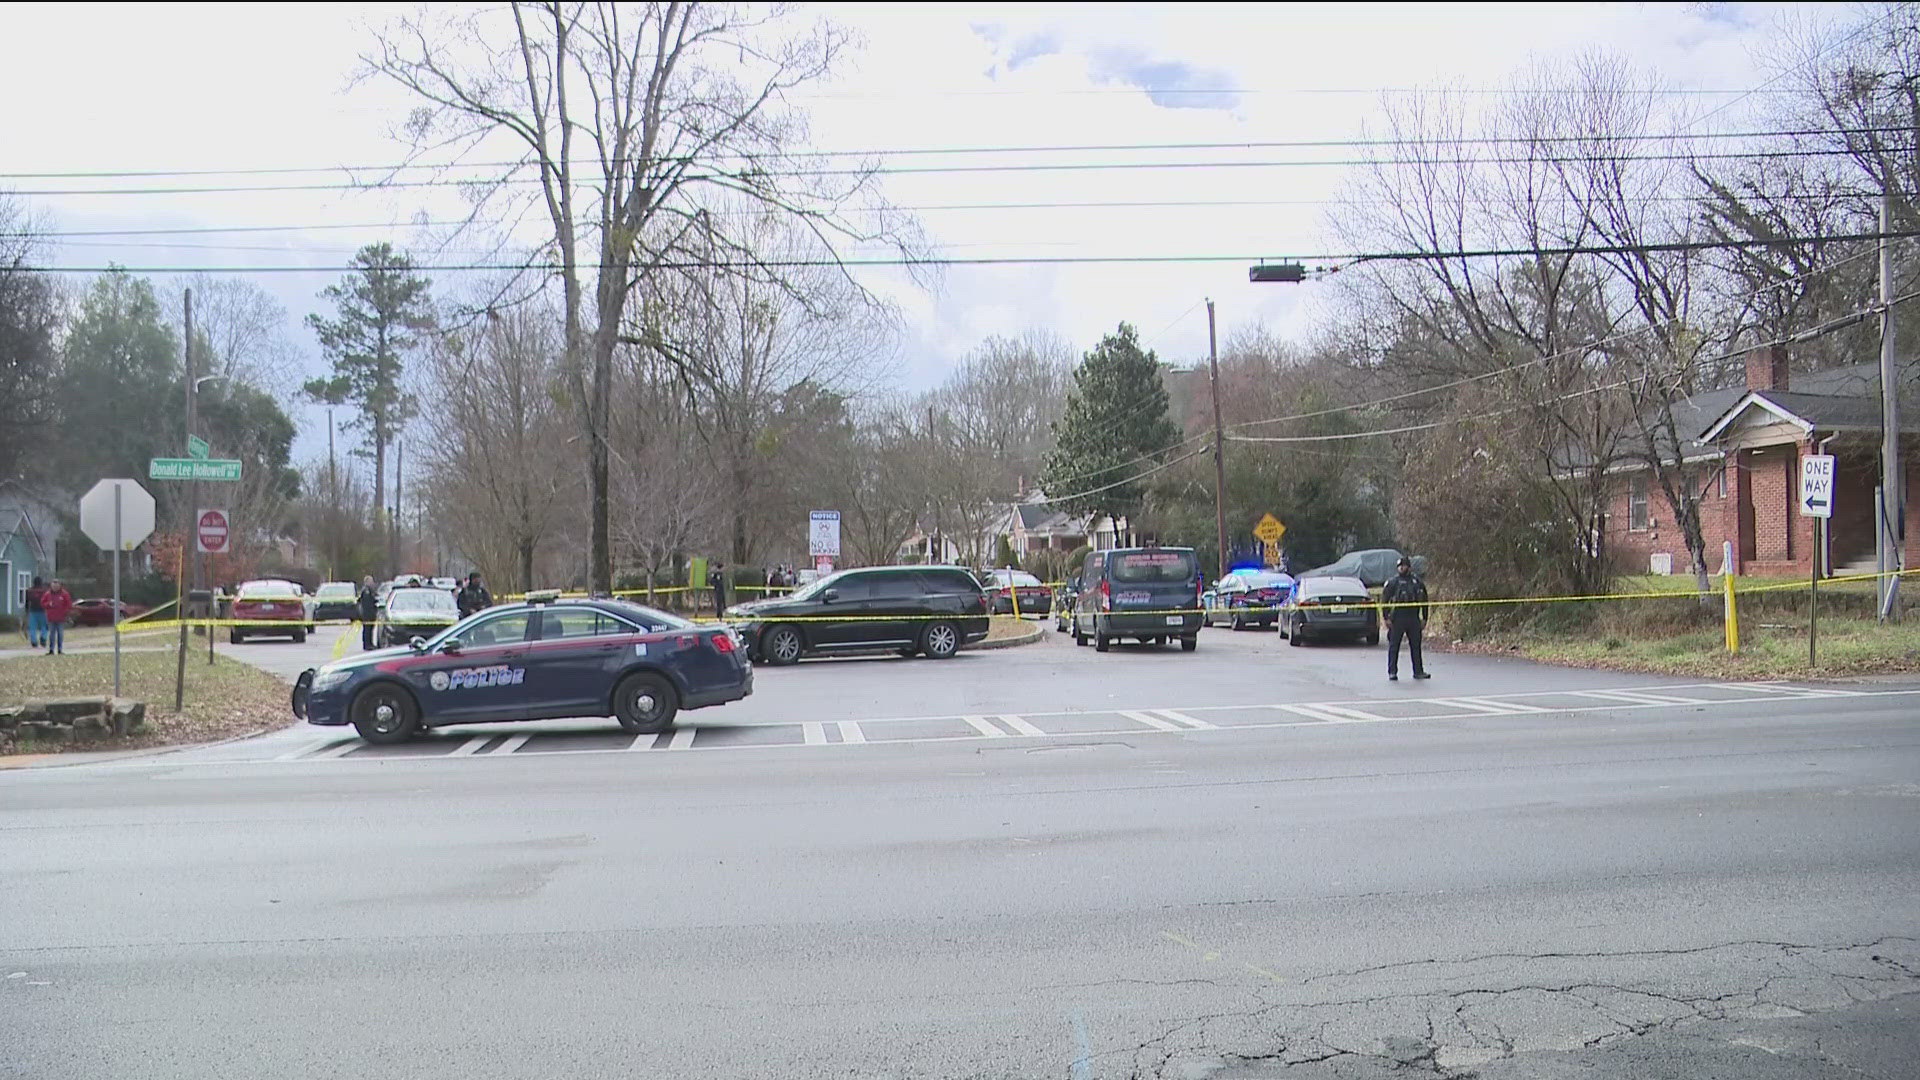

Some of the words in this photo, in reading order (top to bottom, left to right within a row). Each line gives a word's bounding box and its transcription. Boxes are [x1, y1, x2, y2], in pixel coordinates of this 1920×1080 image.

[152, 462, 178, 476] Donald
[178, 463, 192, 476] Lee
[193, 463, 226, 477] Hollowell
[1805, 461, 1830, 475] ONE
[1805, 479, 1829, 492] WAY
[811, 540, 824, 549] NO
[449, 668, 525, 690] POLICE
